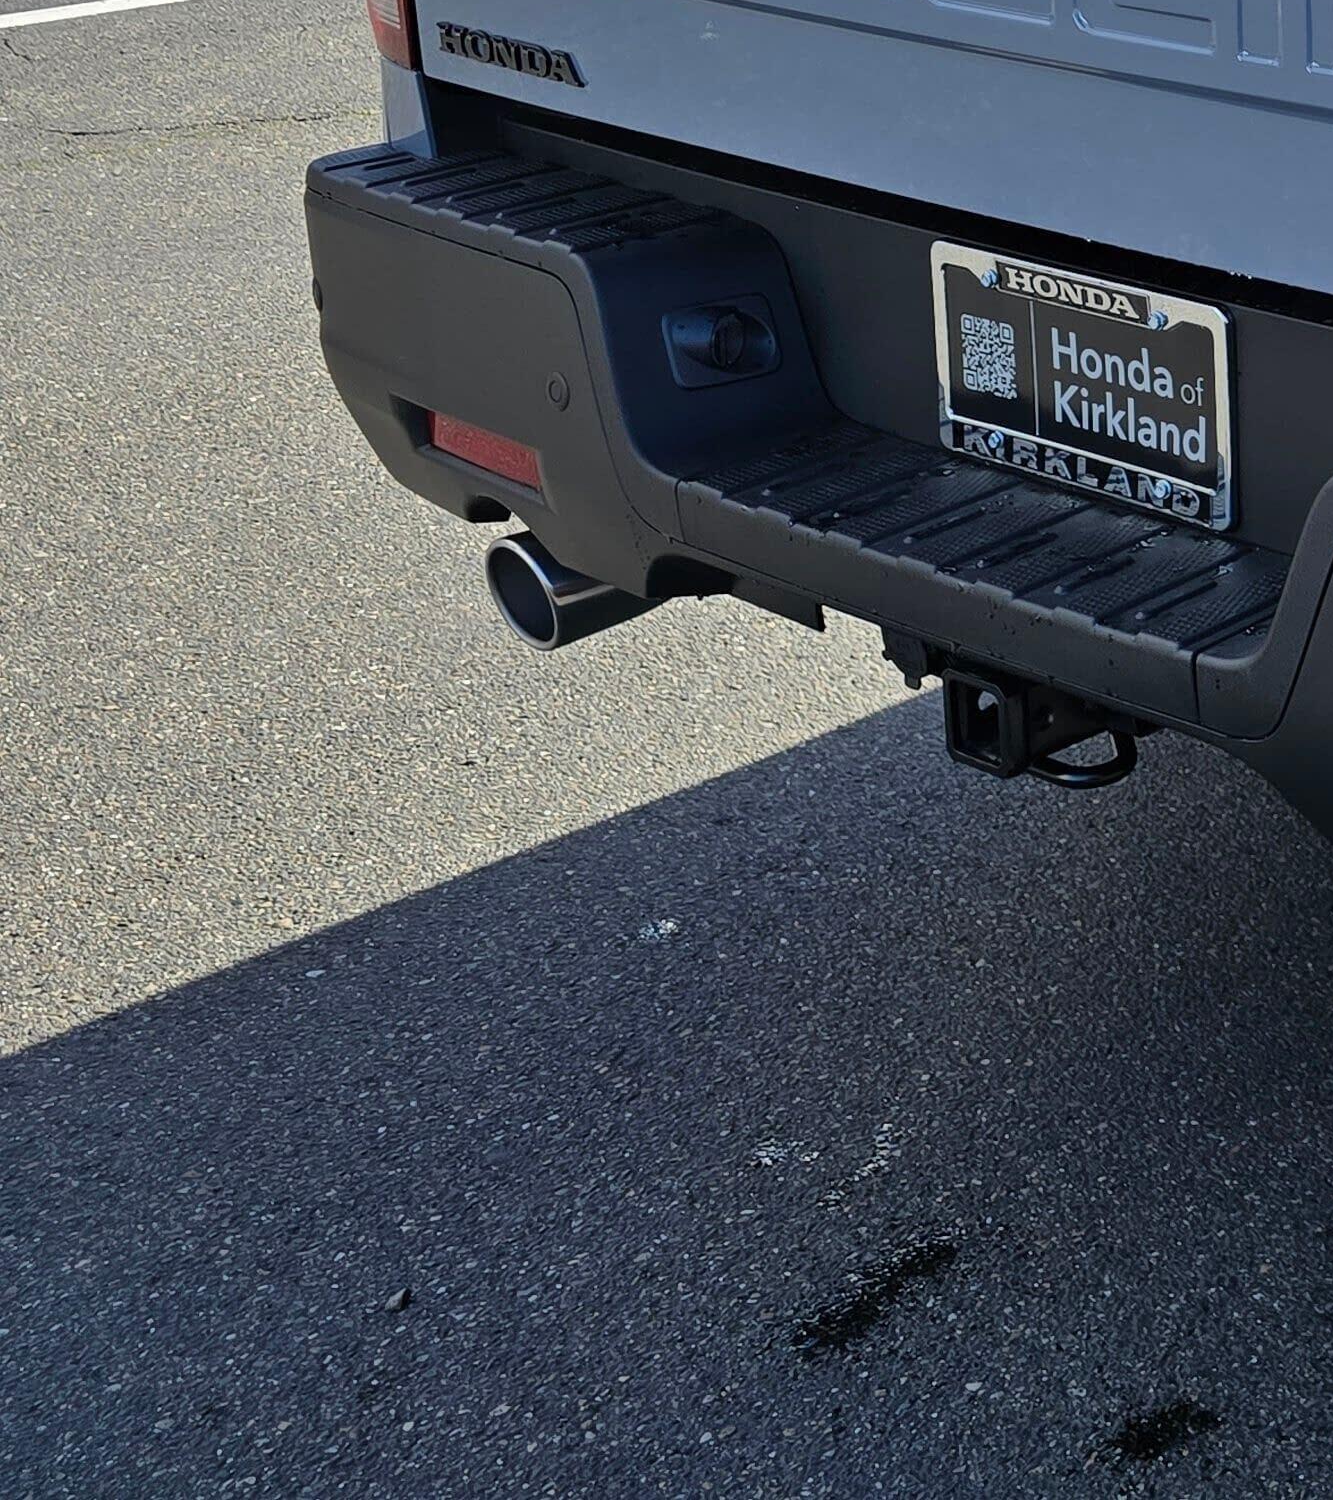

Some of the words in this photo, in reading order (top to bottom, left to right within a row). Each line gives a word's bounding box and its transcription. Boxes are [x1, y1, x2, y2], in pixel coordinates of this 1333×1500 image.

[436, 21, 588, 88] HONDA
[1004, 266, 1140, 320] HONDA
[1051, 327, 1174, 399] Honda
[1180, 377, 1204, 406] of
[1053, 381, 1206, 463] Kirkland
[963, 424, 1200, 516] KIRKLAND
